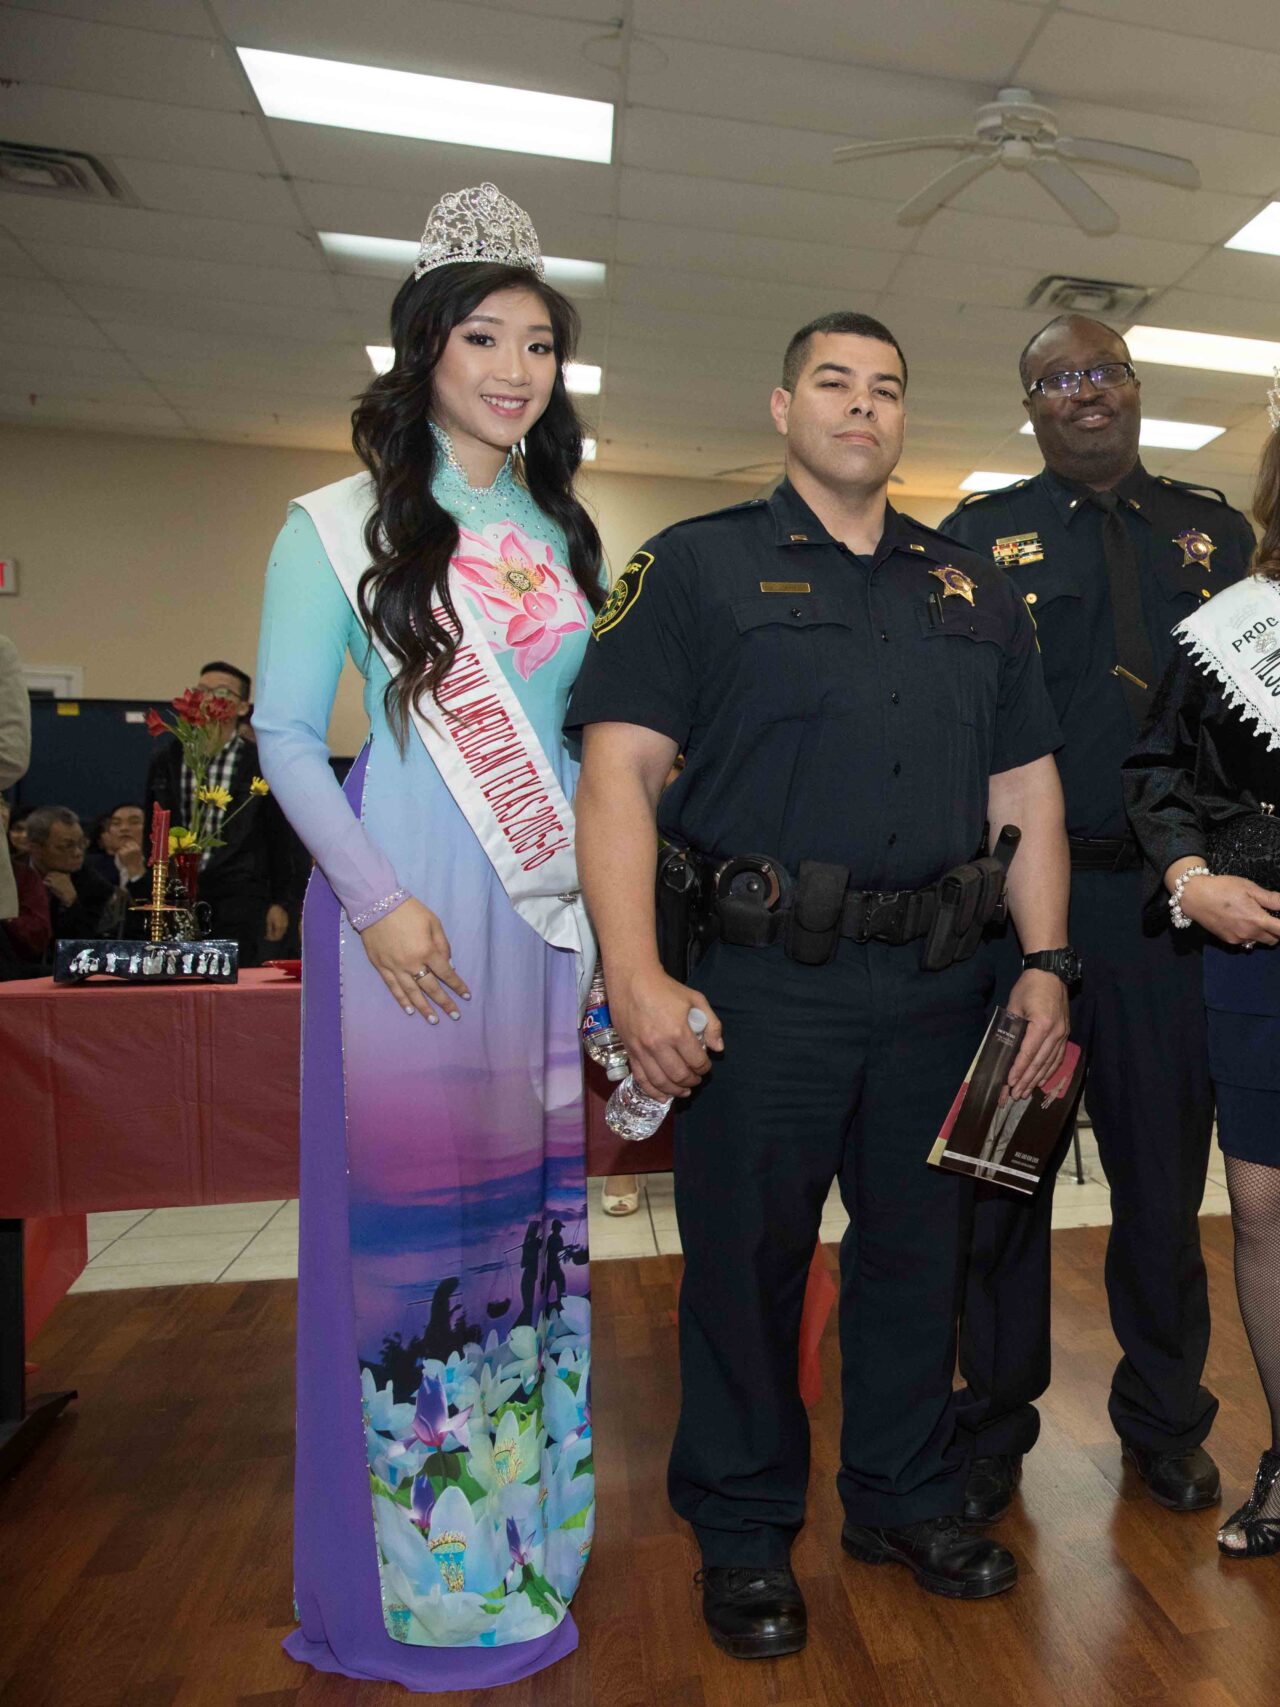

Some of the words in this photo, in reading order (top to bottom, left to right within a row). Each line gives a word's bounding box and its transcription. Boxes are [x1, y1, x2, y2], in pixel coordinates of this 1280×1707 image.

[1231, 616, 1279, 653] PRDC
[441, 693, 527, 779] AMERICAN
[479, 760, 549, 823] TEXAS
[502, 805, 572, 872] 2015-16
